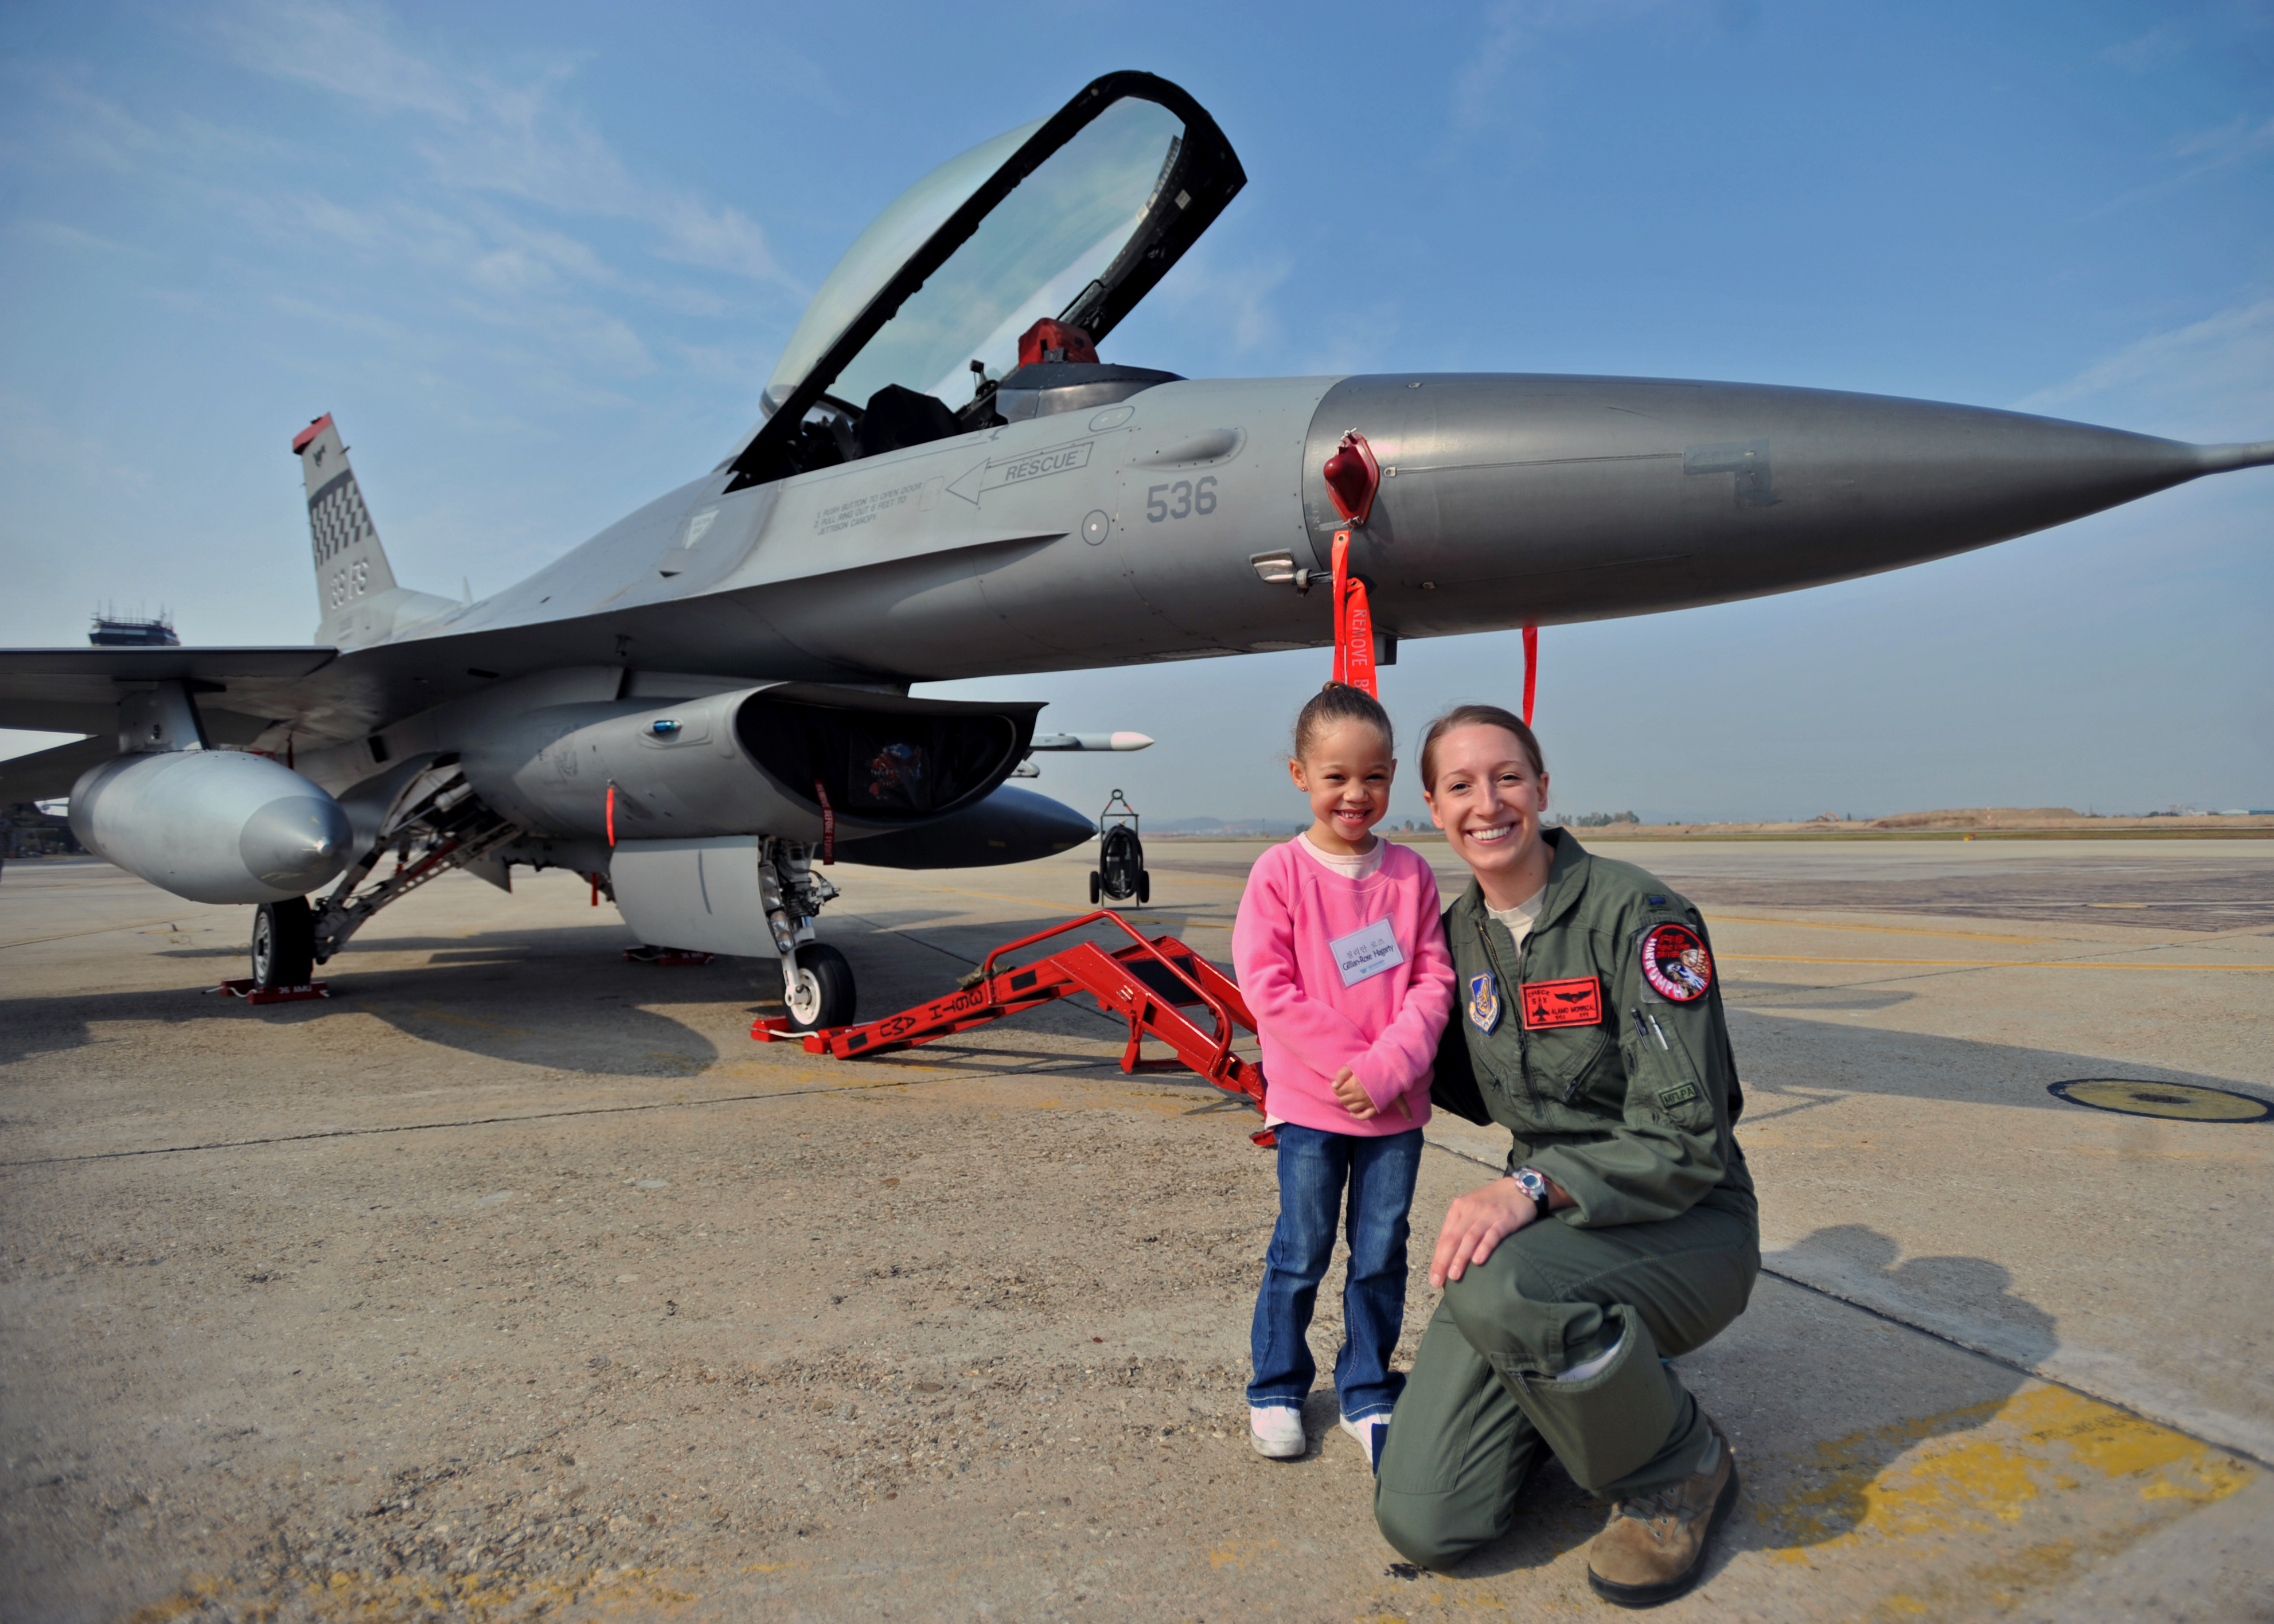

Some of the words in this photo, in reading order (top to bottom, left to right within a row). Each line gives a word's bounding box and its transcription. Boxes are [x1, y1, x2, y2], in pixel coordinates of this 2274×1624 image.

[1005, 450, 1079, 481] RESCUE
[821, 517, 835, 526] PULL
[837, 512, 853, 522] RING
[855, 506, 869, 516] OUT
[877, 498, 895, 510] FEET
[897, 495, 907, 504] TO
[822, 506, 840, 516] PUSH
[841, 498, 867, 511] BUTTON
[869, 494, 878, 503] TO
[880, 489, 899, 500] OPEN
[900, 482, 922, 494] DOOR
[1146, 475, 1218, 523] 536
[817, 521, 848, 536] JETTISON
[850, 513, 877, 527] CANOPY
[1351, 609, 1368, 666] REMOVE
[1645, 938, 1686, 999] HARRUMPH
[929, 990, 984, 1021] 36TH
[880, 1016, 916, 1037] AMU
